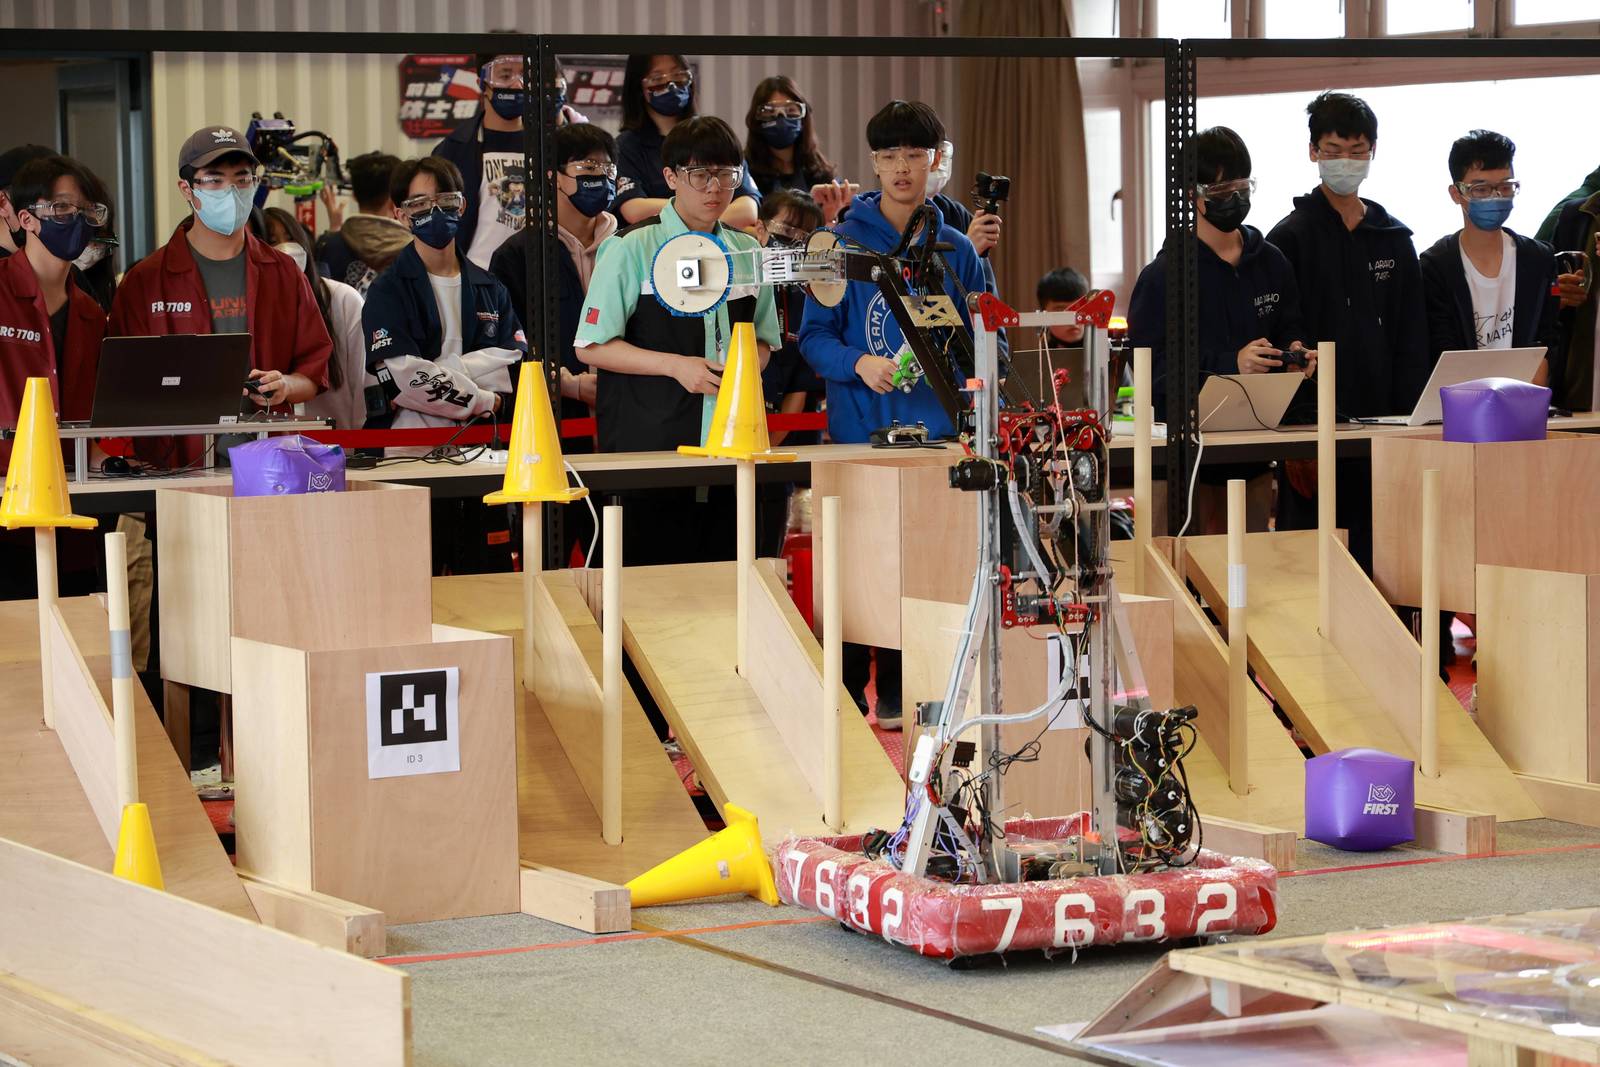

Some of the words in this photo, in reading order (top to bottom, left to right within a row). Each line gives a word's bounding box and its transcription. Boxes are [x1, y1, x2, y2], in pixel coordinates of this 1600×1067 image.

[166, 302, 192, 313] 7709
[16, 329, 41, 342] 7709
[371, 337, 392, 352] FIRST
[406, 754, 416, 764] ID
[417, 753, 424, 763] 3
[1362, 803, 1400, 816] FIRST
[981, 881, 1238, 953] 7632
